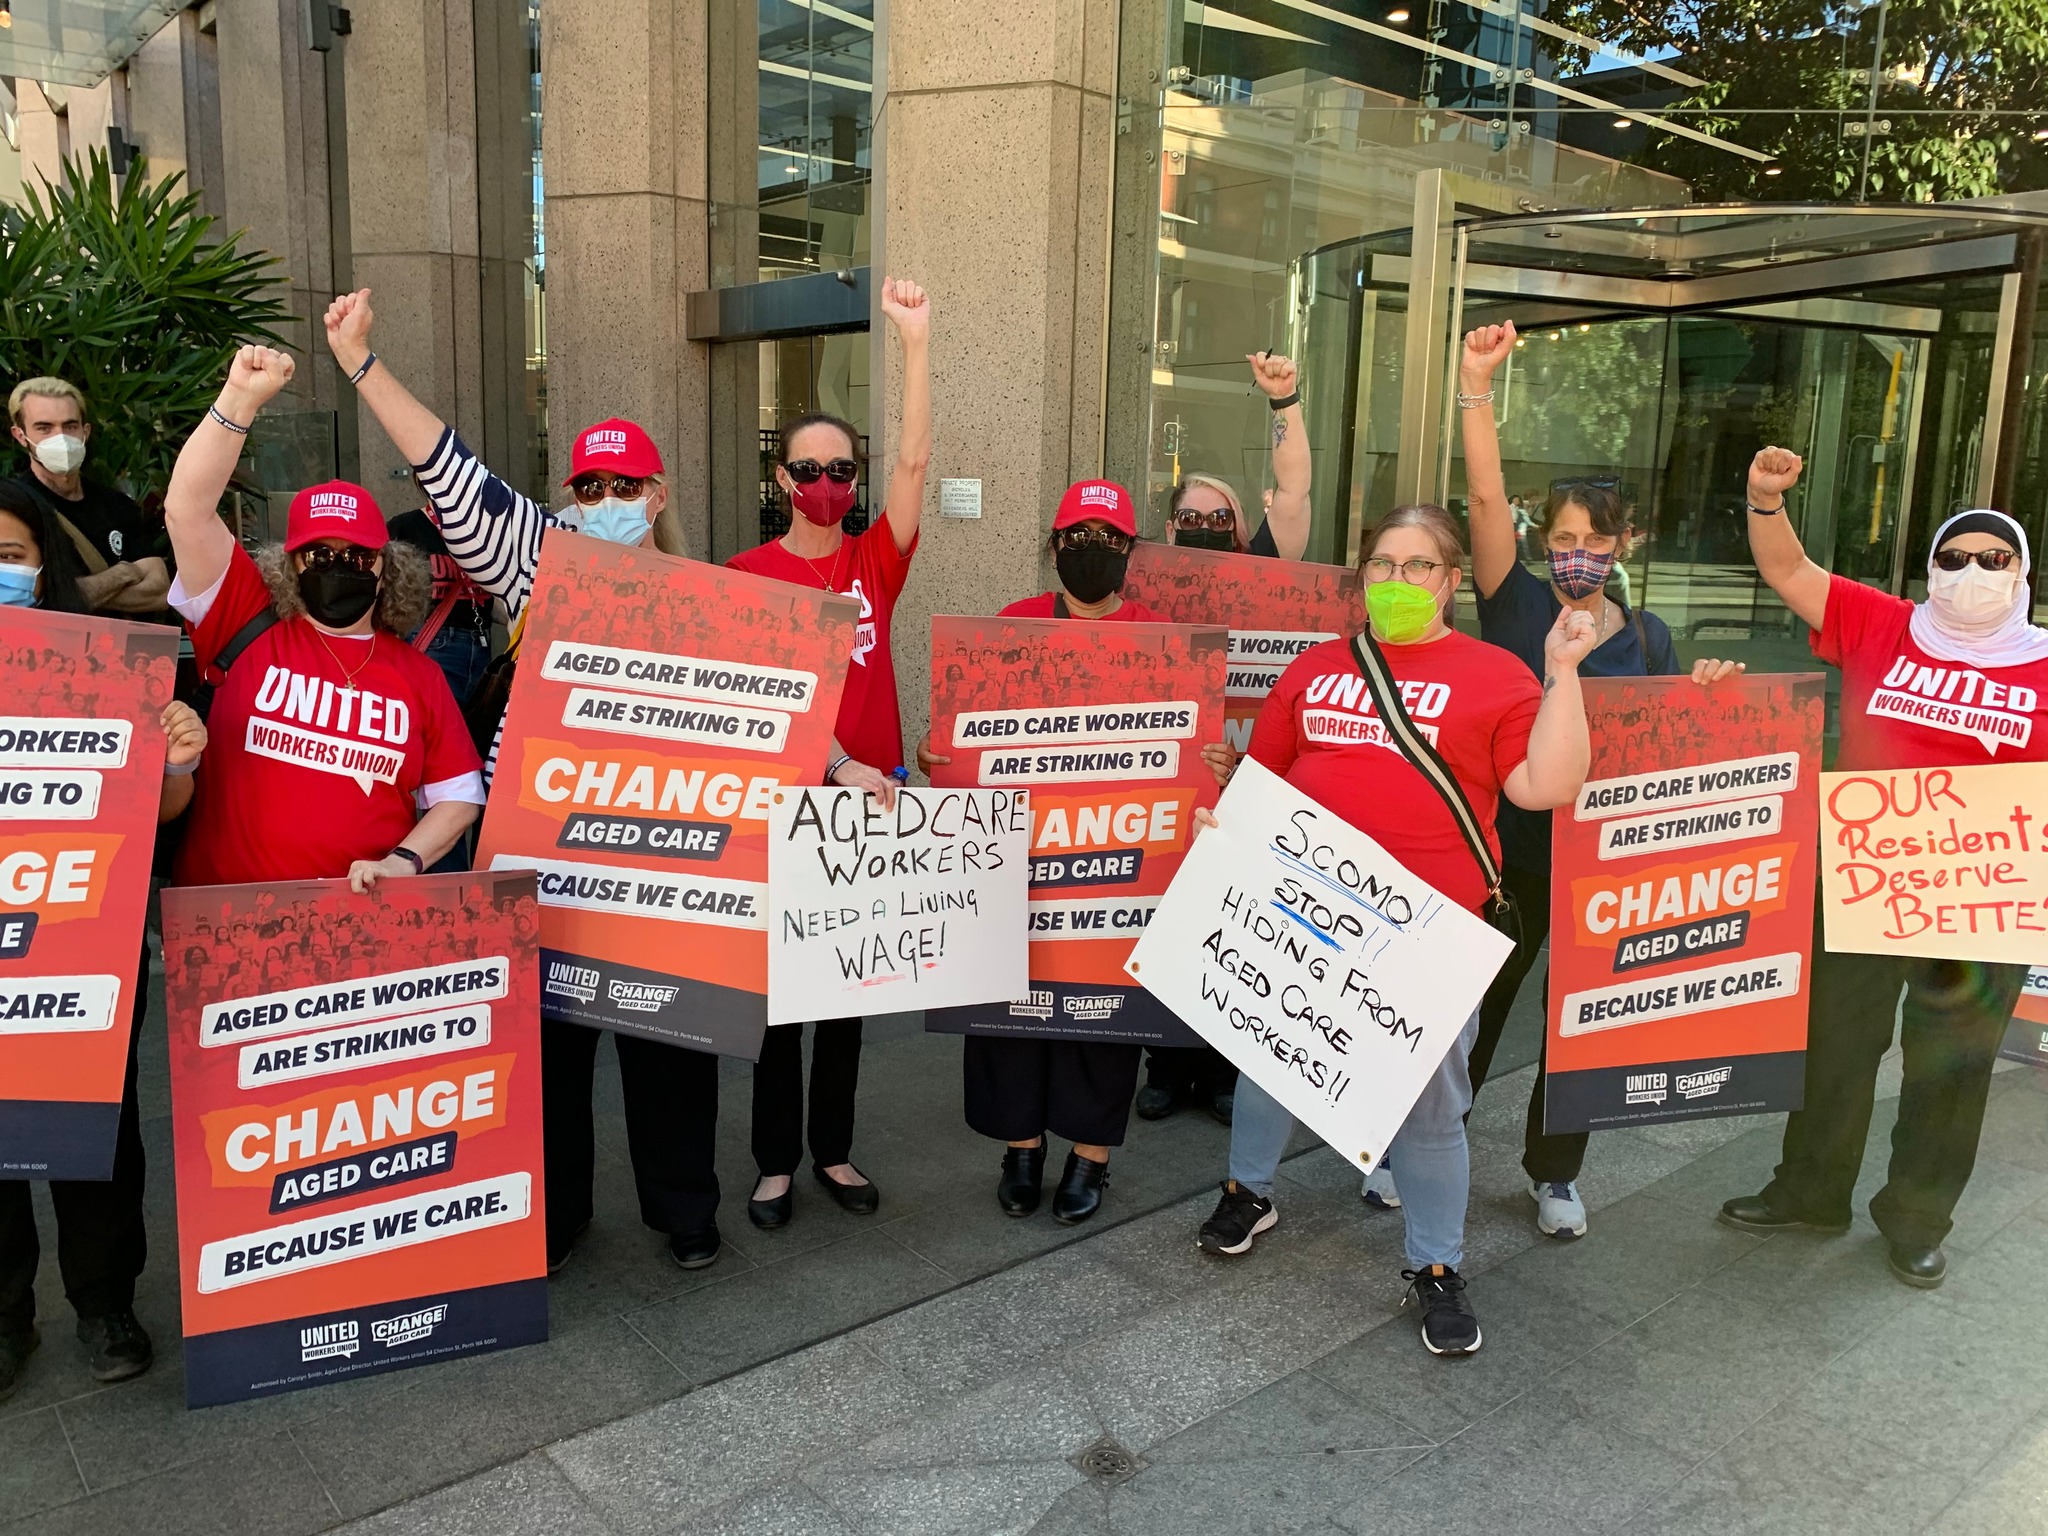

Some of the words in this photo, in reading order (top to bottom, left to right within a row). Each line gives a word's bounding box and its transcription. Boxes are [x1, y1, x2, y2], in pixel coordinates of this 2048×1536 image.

[586, 430, 626, 446] UNITED
[310, 492, 357, 508] UNITED
[1082, 486, 1118, 501] UNITED
[554, 652, 620, 676] AGED
[625, 660, 688, 685] CARE
[693, 668, 808, 700] WORKERS
[1226, 672, 1280, 689] IKING
[1883, 656, 2037, 713] UNITED
[254, 664, 410, 744] UNITED
[576, 699, 627, 722] ARE
[630, 705, 740, 735] STRIKING
[745, 718, 775, 740] TO
[1874, 694, 1962, 726] WORKERS
[1964, 712, 2026, 740] UNION
[962, 720, 1020, 738] AGED
[1024, 716, 1080, 734] CARE
[1085, 711, 1190, 732] WORKERS
[1306, 716, 1380, 741] WORKERS
[252, 724, 338, 765] WORKERS
[342, 748, 398, 778] UNION
[989, 757, 1032, 775] ARE
[1036, 752, 1133, 772] STRIKING
[1140, 750, 1167, 768] TO
[42, 782, 82, 806] TO
[534, 757, 780, 820] CHANGE
[1584, 786, 1638, 810] AGED
[1642, 777, 1694, 800] CARE
[1699, 762, 1792, 792] WORKERS
[1828, 769, 1966, 826] OUR
[566, 821, 642, 847] AGED
[647, 826, 721, 852] CARE
[1029, 800, 1179, 850] ANGE
[1610, 825, 1648, 848] ARE
[1652, 811, 1742, 840] STRIKING
[1747, 806, 1772, 826] TO
[817, 841, 1004, 886] WORKERS
[1072, 856, 1134, 878] CARE
[1586, 856, 1782, 934] CHANGE
[1836, 862, 2028, 905] Deserve
[636, 884, 678, 906] WE
[682, 889, 756, 918] CARE.
[784, 908, 860, 945] NEED
[872, 898, 886, 920] A
[1071, 910, 1106, 930] WE
[836, 921, 946, 983] WAGE!
[1620, 934, 1679, 964] AGED
[1684, 920, 1742, 948] CARE
[548, 983, 575, 995] WORKERS
[576, 988, 594, 998] UNION
[549, 962, 600, 988] UNITED
[1202, 928, 1271, 998] AGED
[1282, 985, 1352, 1056] CARE
[212, 1005, 288, 1035] AGED
[295, 989, 366, 1019] CARE
[372, 967, 500, 1001] WORKERS
[612, 984, 674, 1002] CHANGE
[620, 1000, 638, 1009] AGED
[640, 1002, 658, 1010] CARE
[1066, 998, 1120, 1011] CHANGE
[1578, 986, 1678, 1024] BECAUSE
[1684, 980, 1716, 1004] WE
[1720, 968, 1782, 996] CARE.
[1011, 1007, 1035, 1015] WORKERS
[1341, 968, 1424, 1053] FROM
[253, 1050, 307, 1075] ARE
[314, 1024, 436, 1063] STRIKING
[443, 1016, 477, 1038] TO
[1202, 972, 1351, 1108] WORKERS!!
[1626, 1072, 1668, 1092] UNITED
[1628, 1092, 1650, 1101] WORKERS
[1650, 1092, 1665, 1100] UNION
[1678, 1070, 1728, 1090] CHANGE
[1688, 1088, 1702, 1097] AGED
[1703, 1085, 1718, 1094] CARE
[225, 1070, 496, 1172] CHANGE
[278, 1165, 362, 1204] AGED
[370, 1141, 447, 1181] CARE
[224, 1222, 365, 1277] BECAUSE
[373, 1209, 419, 1239] WE
[424, 1191, 508, 1227] CARE.
[301, 1320, 359, 1348] UNITED
[376, 1308, 443, 1338] CHANGE
[388, 1332, 409, 1344] AGED
[410, 1327, 430, 1339] CARE
[304, 1346, 336, 1359] WORKERS
[337, 1342, 358, 1354] UNION
[251, 1379, 279, 1389] Authorised
[390, 1355, 410, 1363] Workers
